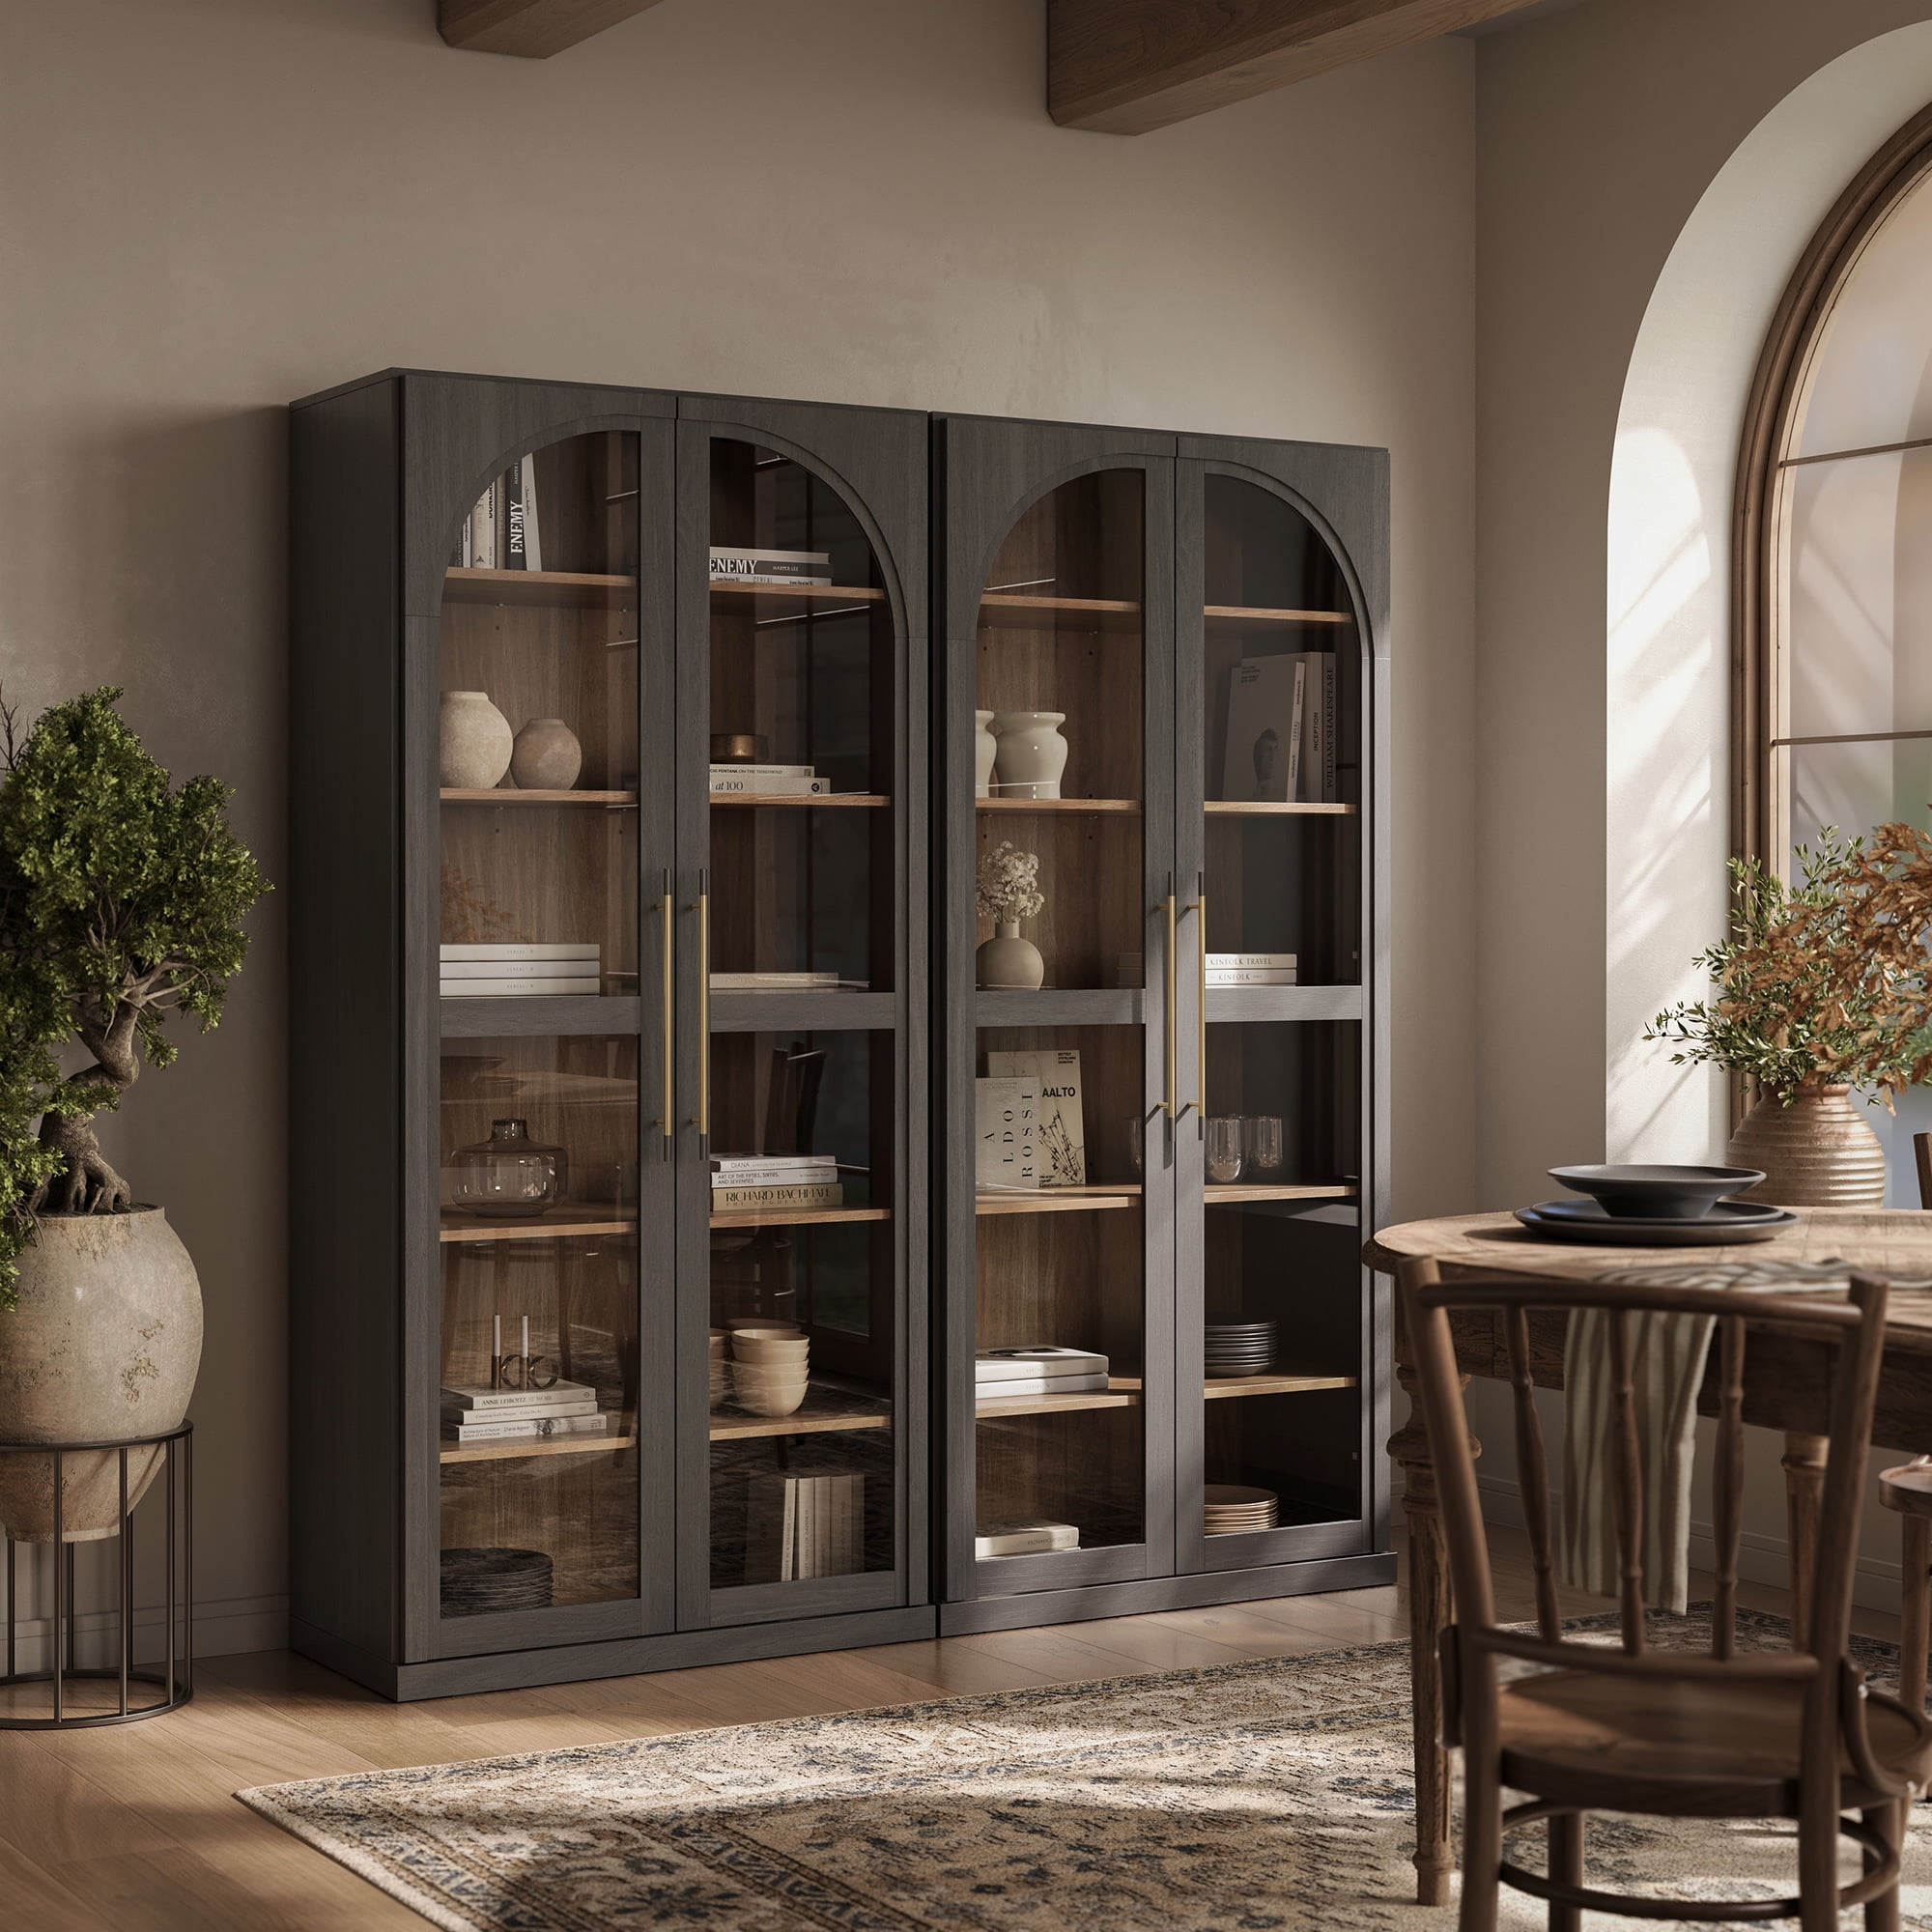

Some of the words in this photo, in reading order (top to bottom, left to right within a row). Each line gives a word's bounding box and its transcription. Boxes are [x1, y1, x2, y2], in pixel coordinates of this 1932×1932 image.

[510, 500, 523, 554] ENEMY
[709, 557, 757, 574] ENEMY
[715, 781, 724, 790] at
[726, 781, 743, 790] 100
[1042, 1087, 1075, 1097] AALTO
[1022, 1094, 1034, 1178] ROSSI
[725, 1189, 774, 1202] RICHARD
[777, 1187, 829, 1200] BACHMAN
